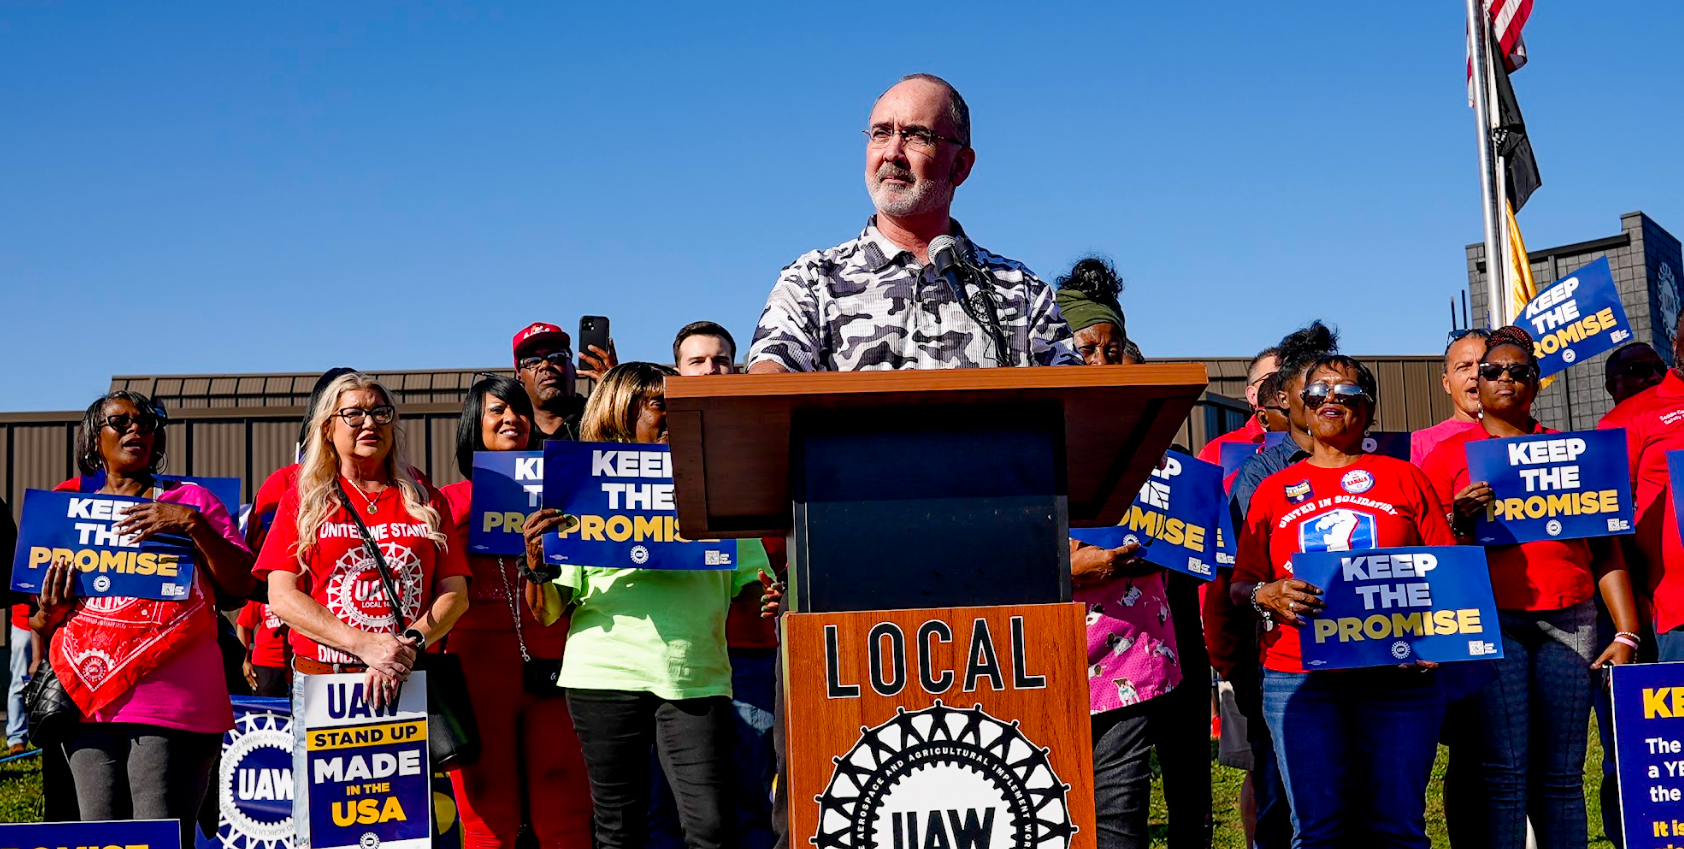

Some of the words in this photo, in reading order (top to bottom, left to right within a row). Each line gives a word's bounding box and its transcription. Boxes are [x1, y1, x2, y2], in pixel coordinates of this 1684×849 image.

[1526, 277, 1579, 320] KEEP
[1531, 299, 1580, 334] THE
[1533, 307, 1617, 359] ROMISE
[1507, 437, 1586, 466] KEEP
[1519, 465, 1580, 494] THE
[67, 498, 140, 522] KEE
[602, 483, 676, 510] THE
[1486, 489, 1619, 523] PROMISE
[1279, 502, 1316, 528] UNITED
[1318, 498, 1332, 508] IN
[366, 524, 389, 541] WE
[559, 515, 721, 543] PROMI
[1341, 553, 1438, 581] KEEP
[1355, 582, 1432, 610] THE
[1313, 608, 1483, 643] PROMISE
[824, 616, 1047, 699] LOCAL
[328, 682, 403, 719] UAW
[314, 729, 383, 747] STAND
[391, 725, 418, 741] UP
[1645, 737, 1682, 755] The
[313, 749, 421, 784] MADE
[1648, 765, 1660, 779] a
[238, 768, 294, 800] UAW
[346, 784, 361, 796] IN
[363, 782, 391, 794] THE
[857, 777, 884, 839] AEROSPACE
[885, 760, 904, 777] AND
[908, 747, 988, 766] AGRICULTURAL
[992, 763, 1031, 819] IMPLEMENT
[1650, 785, 1682, 803] the
[332, 796, 407, 827] USA
[892, 806, 996, 849] UAW
[1653, 820, 1669, 838] It
